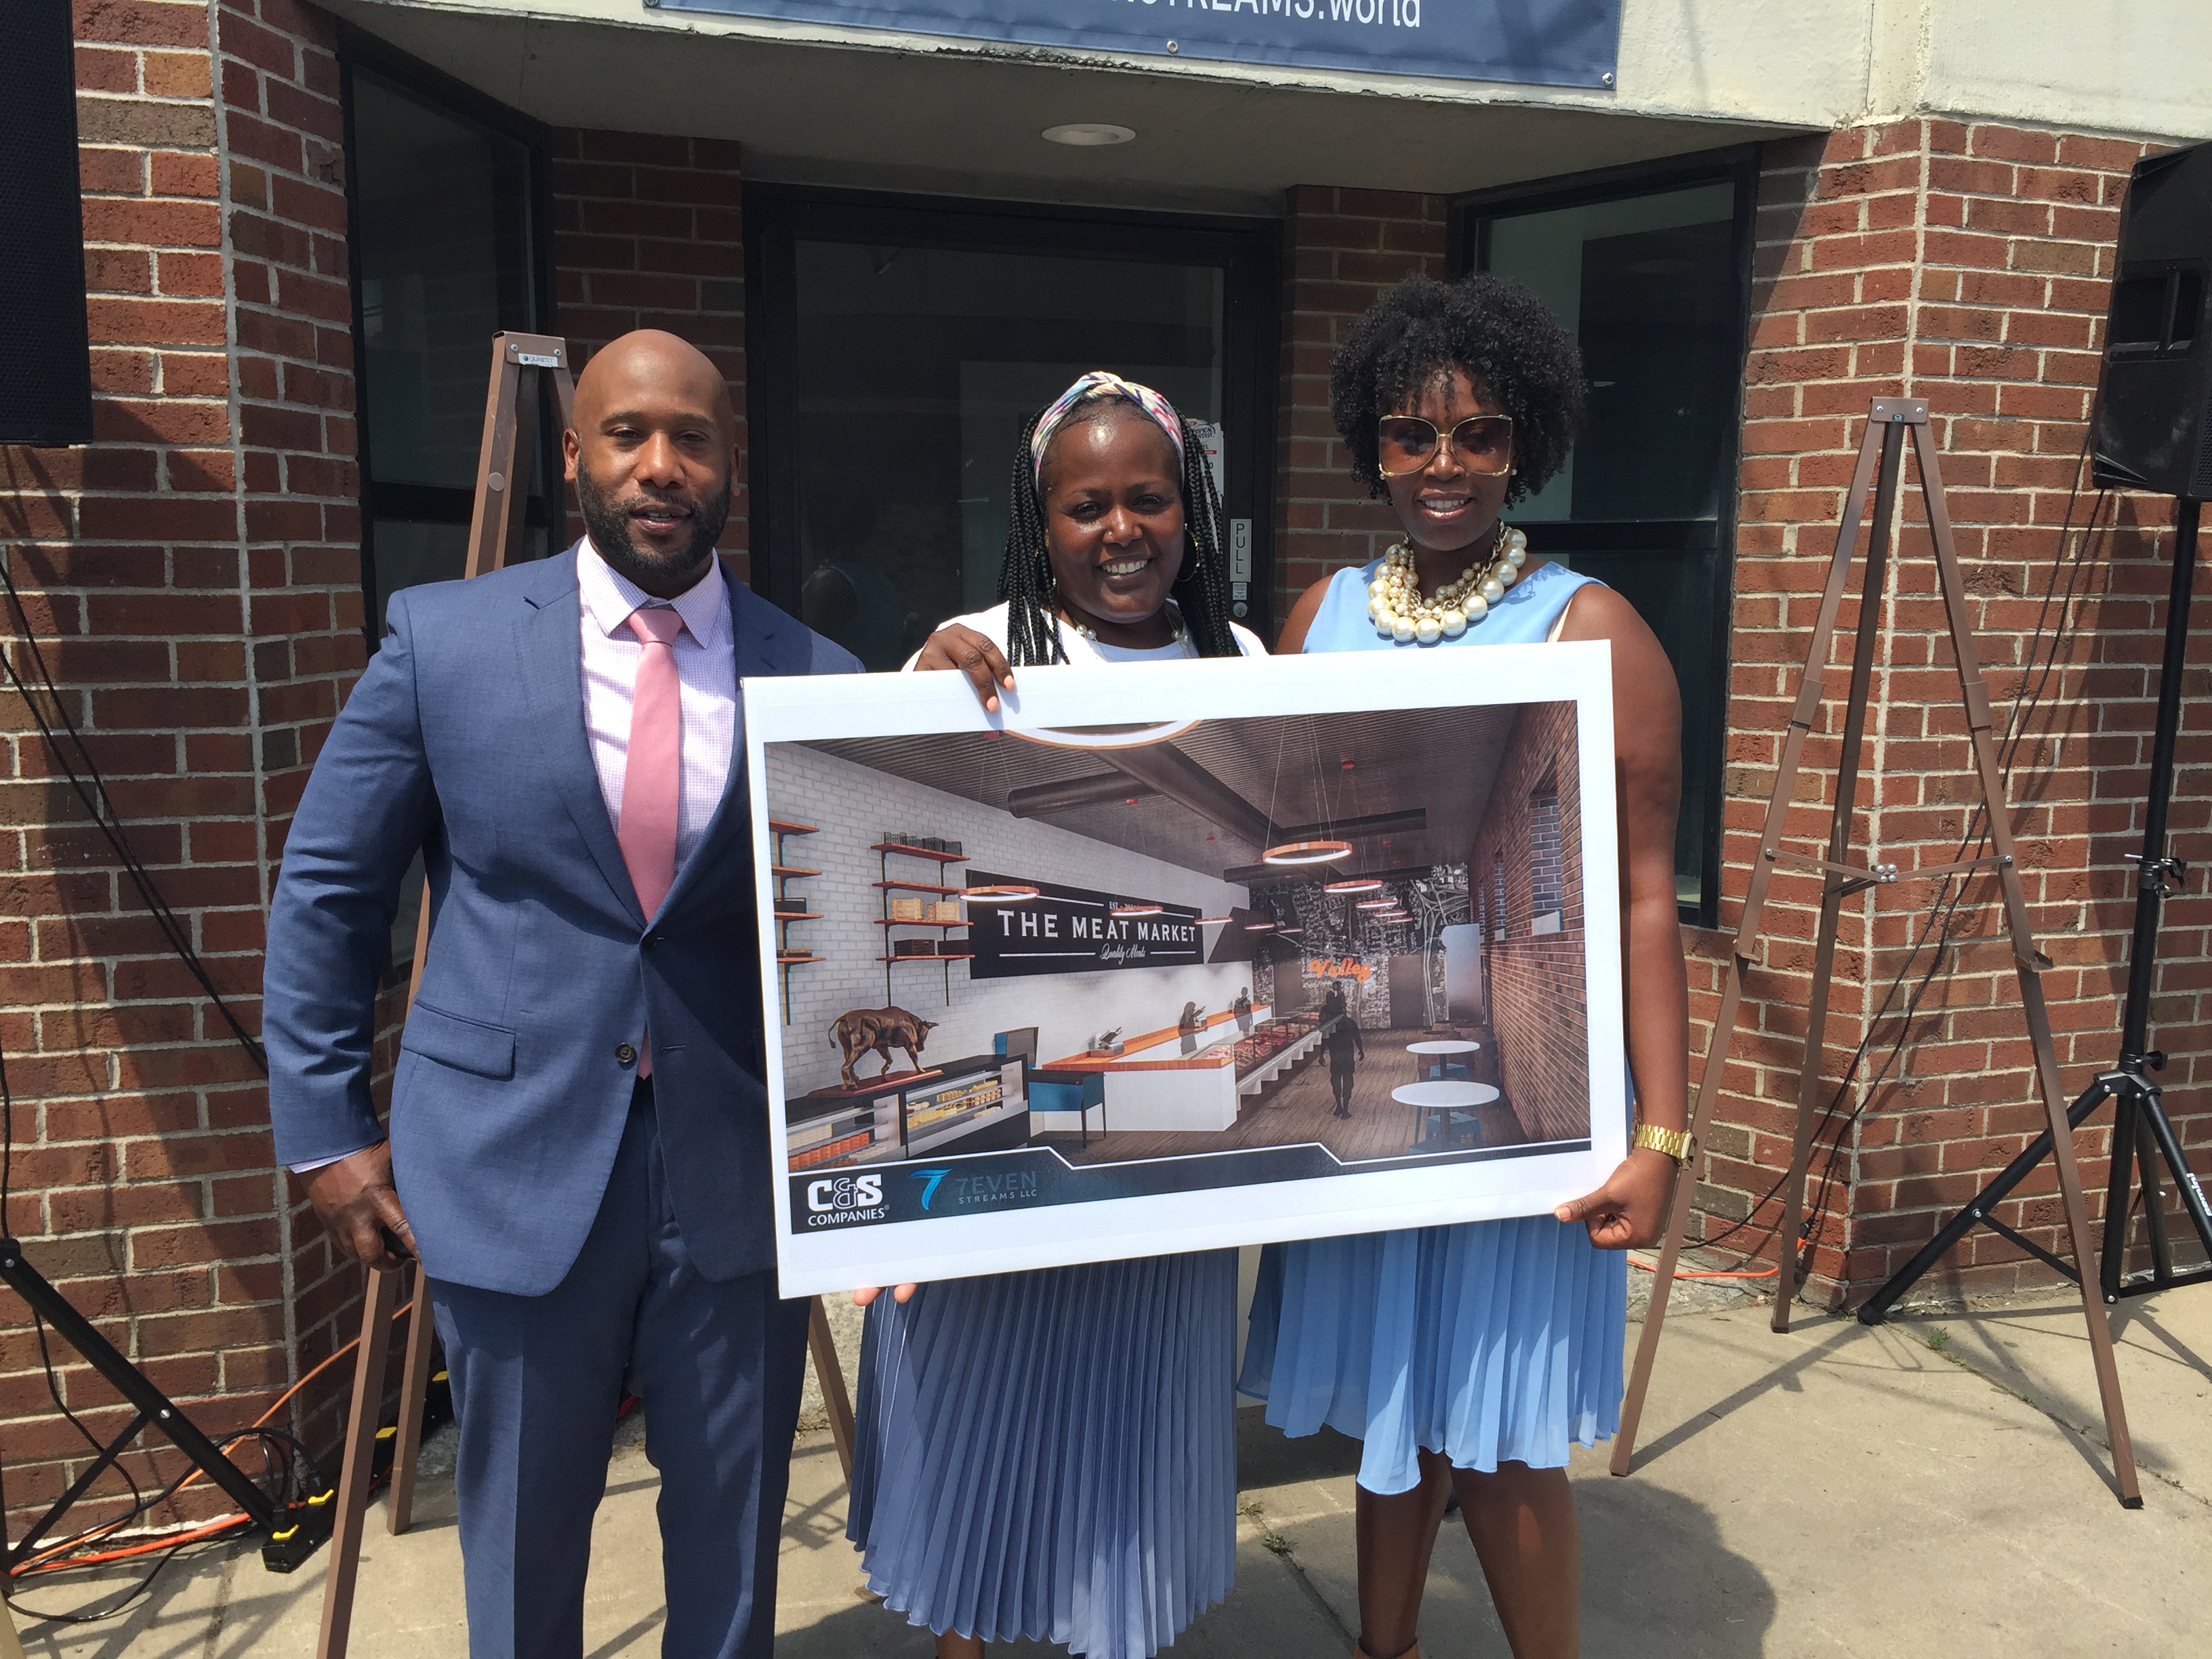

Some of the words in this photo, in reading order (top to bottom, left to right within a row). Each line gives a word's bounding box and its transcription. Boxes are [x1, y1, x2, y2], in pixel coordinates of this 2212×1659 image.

[1236, 523, 1246, 574] PULL
[997, 909, 1059, 939] THE
[1072, 916, 1129, 940] MEAT
[1137, 922, 1195, 943] MARKET
[1099, 943, 1125, 965] Quality
[1126, 943, 1147, 959] Meats
[1309, 956, 1373, 984] Valley
[807, 1173, 883, 1212] C&S
[956, 1170, 1037, 1196] 7EVEN
[958, 1192, 1016, 1205] STREAMS
[1020, 1189, 1038, 1198] LLC
[808, 1206, 886, 1227] COMPANIES
